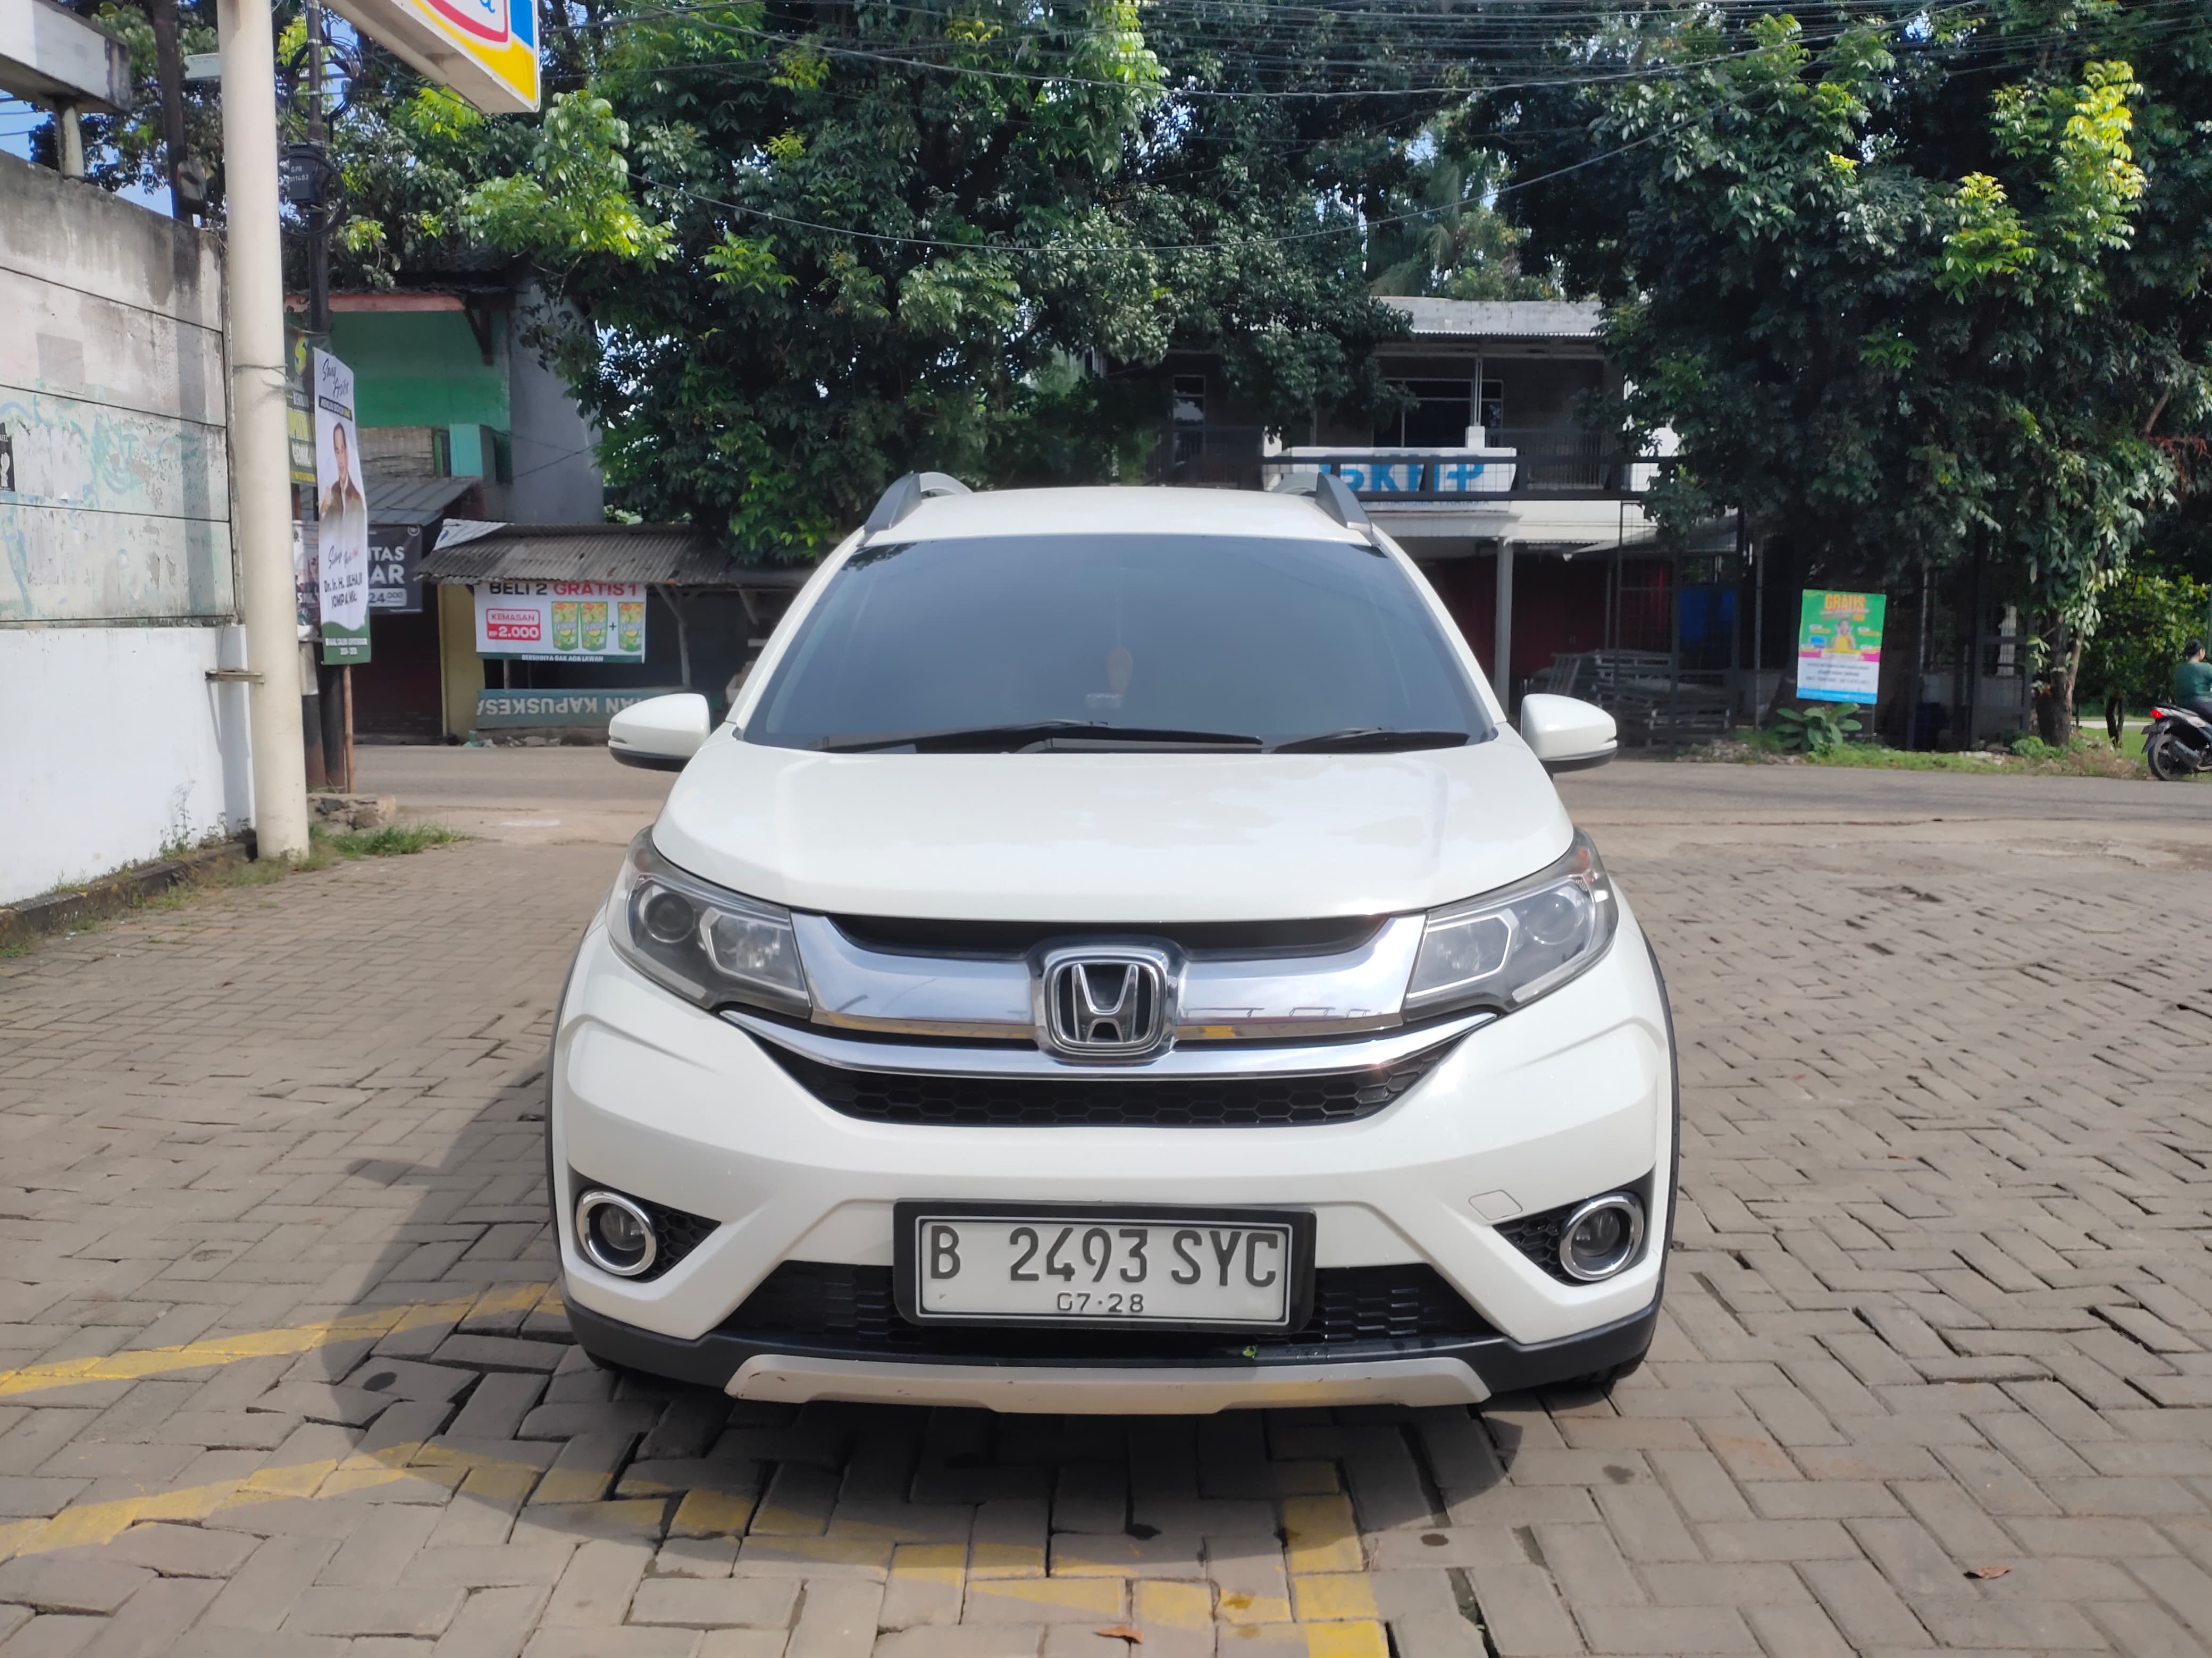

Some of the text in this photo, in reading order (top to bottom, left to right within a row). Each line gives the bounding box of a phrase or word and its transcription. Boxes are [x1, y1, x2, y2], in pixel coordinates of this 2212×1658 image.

[369, 563, 405, 584] AR
[489, 583, 637, 596] BELI 2 GRATIS 1
[491, 613, 535, 621] KEMASAN
[498, 626, 539, 638] 2.000
[931, 1225, 1279, 1287] B 2493 SYC
